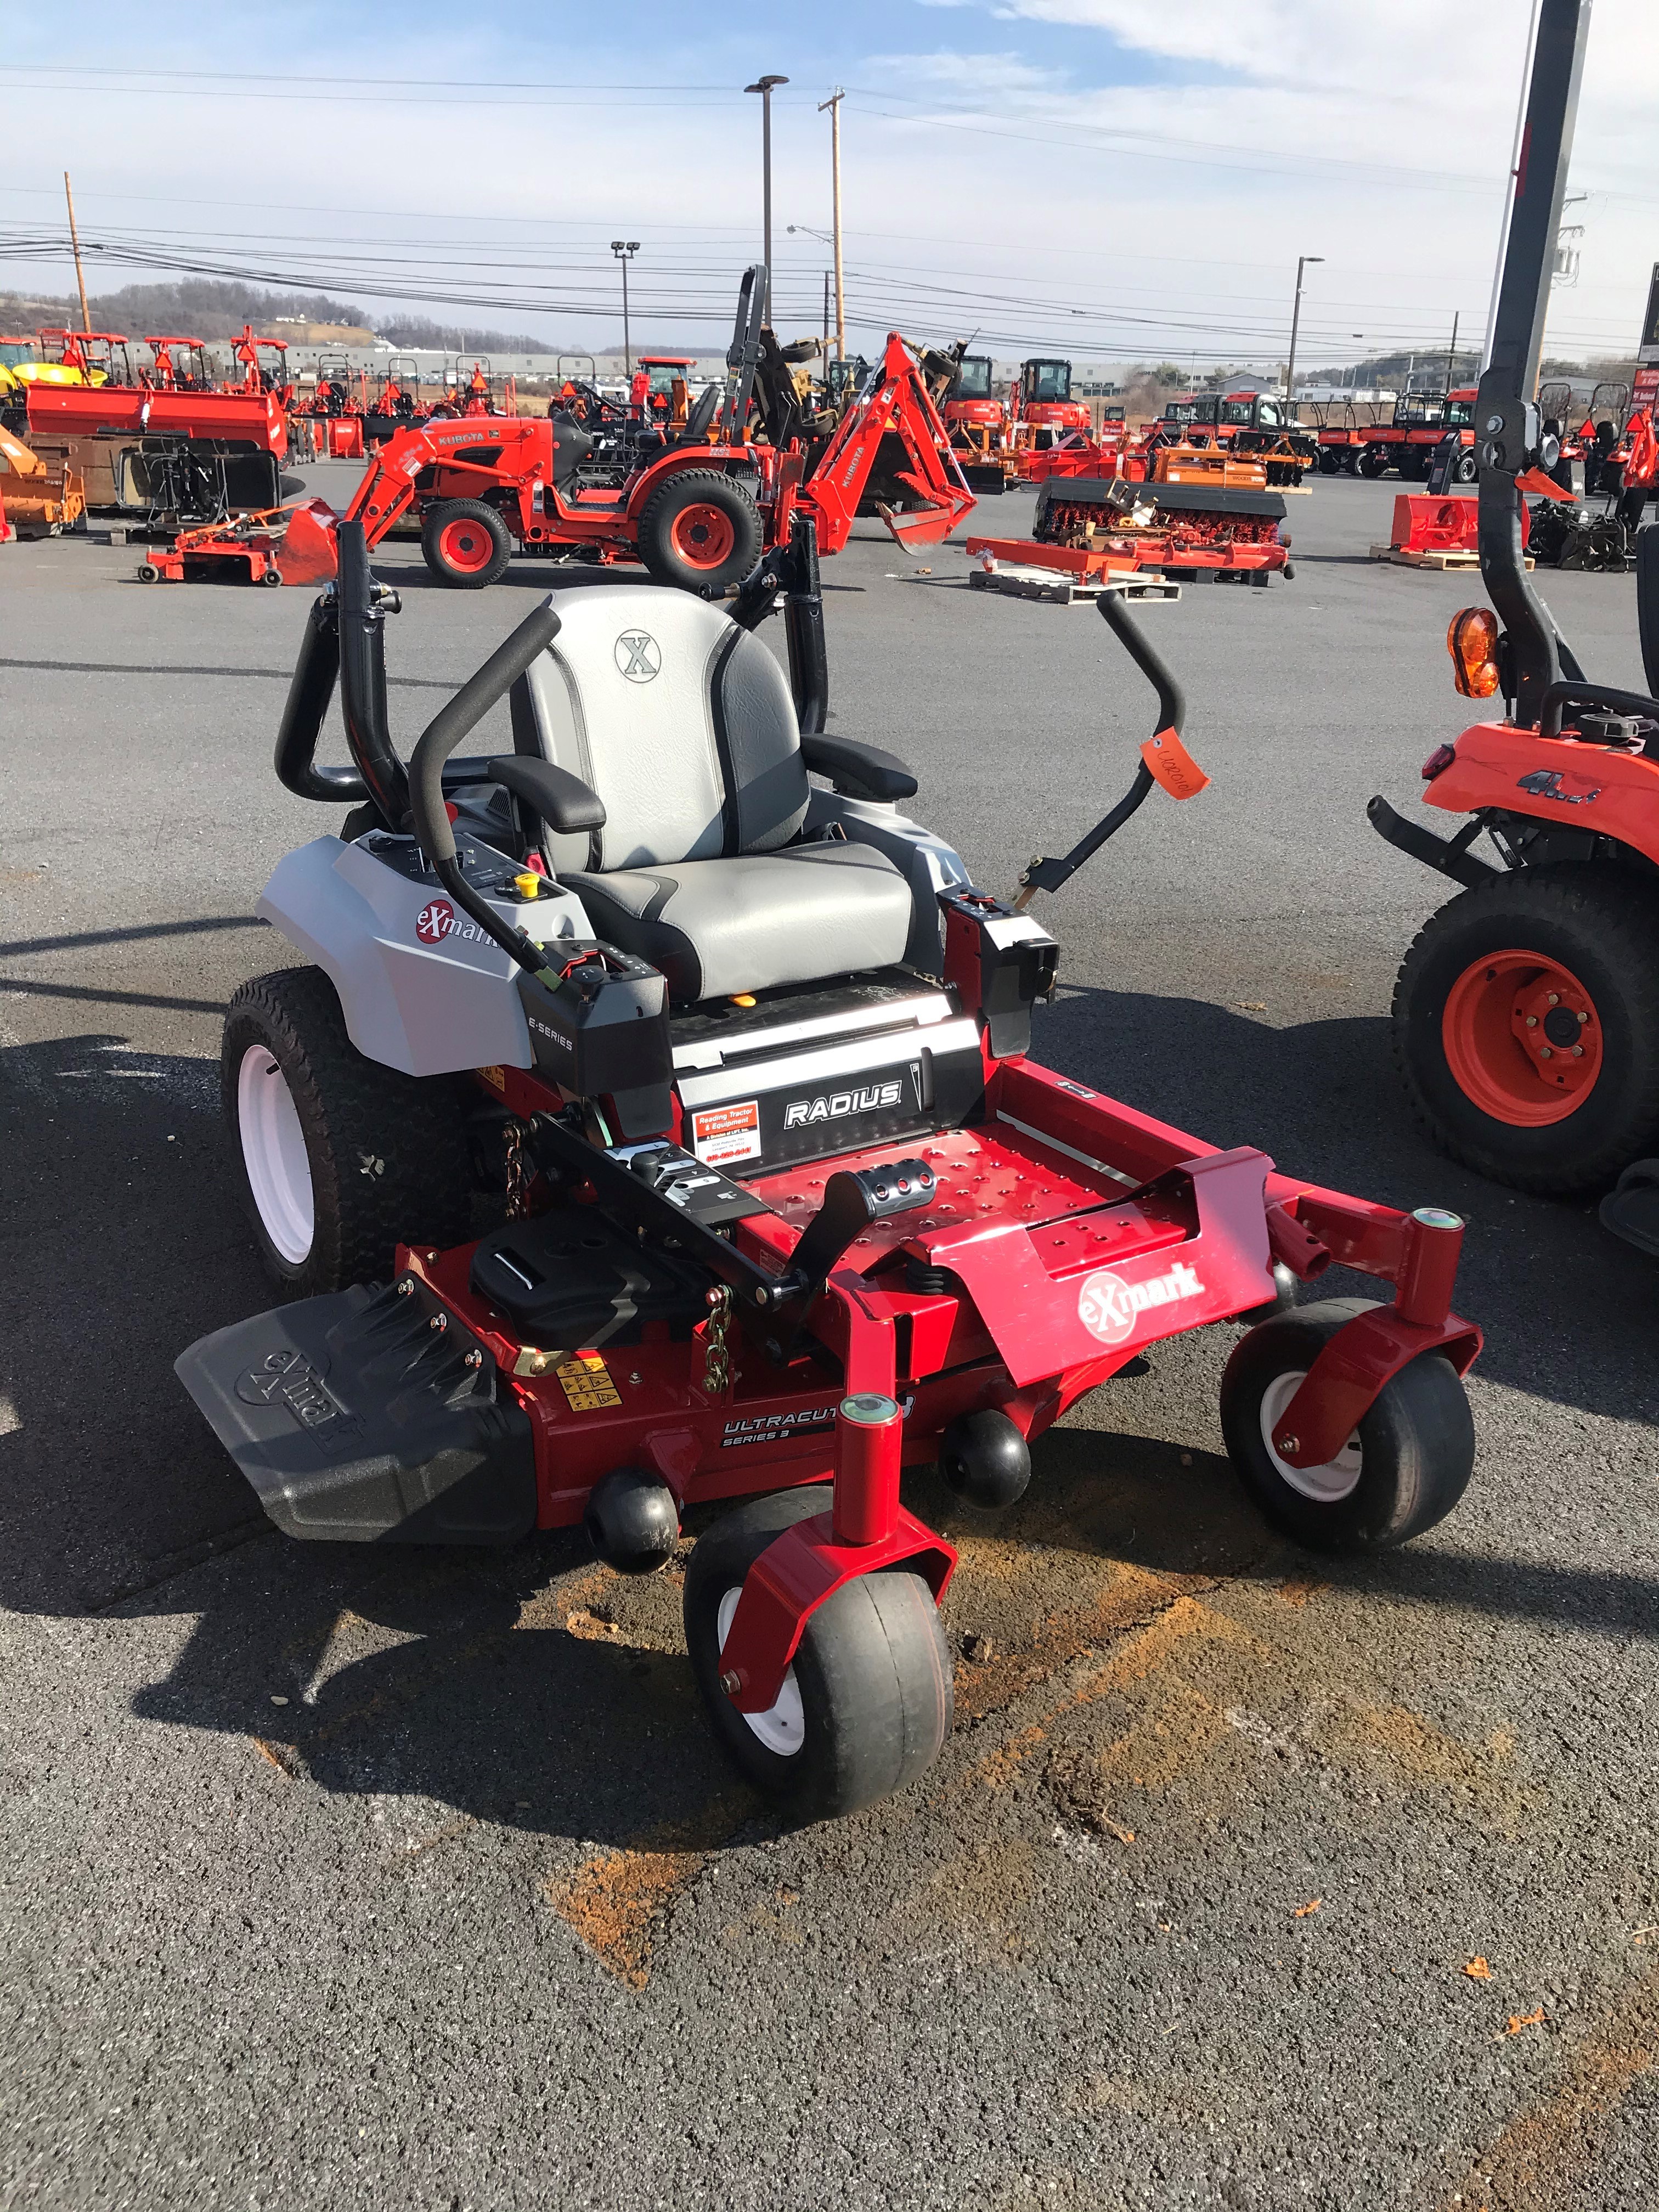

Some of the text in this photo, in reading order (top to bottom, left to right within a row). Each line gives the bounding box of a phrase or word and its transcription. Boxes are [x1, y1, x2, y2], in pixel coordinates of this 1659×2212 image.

[438, 432, 486, 446] KUBOTA
[842, 446, 866, 488] KUBOTA
[786, 1081, 901, 1128] RADIUS
[699, 1108, 753, 1125] Reading Tractor
[712, 1117, 749, 1130] Equipment
[1079, 1262, 1205, 1333] eXmark
[723, 1432, 776, 1447] SERIES
